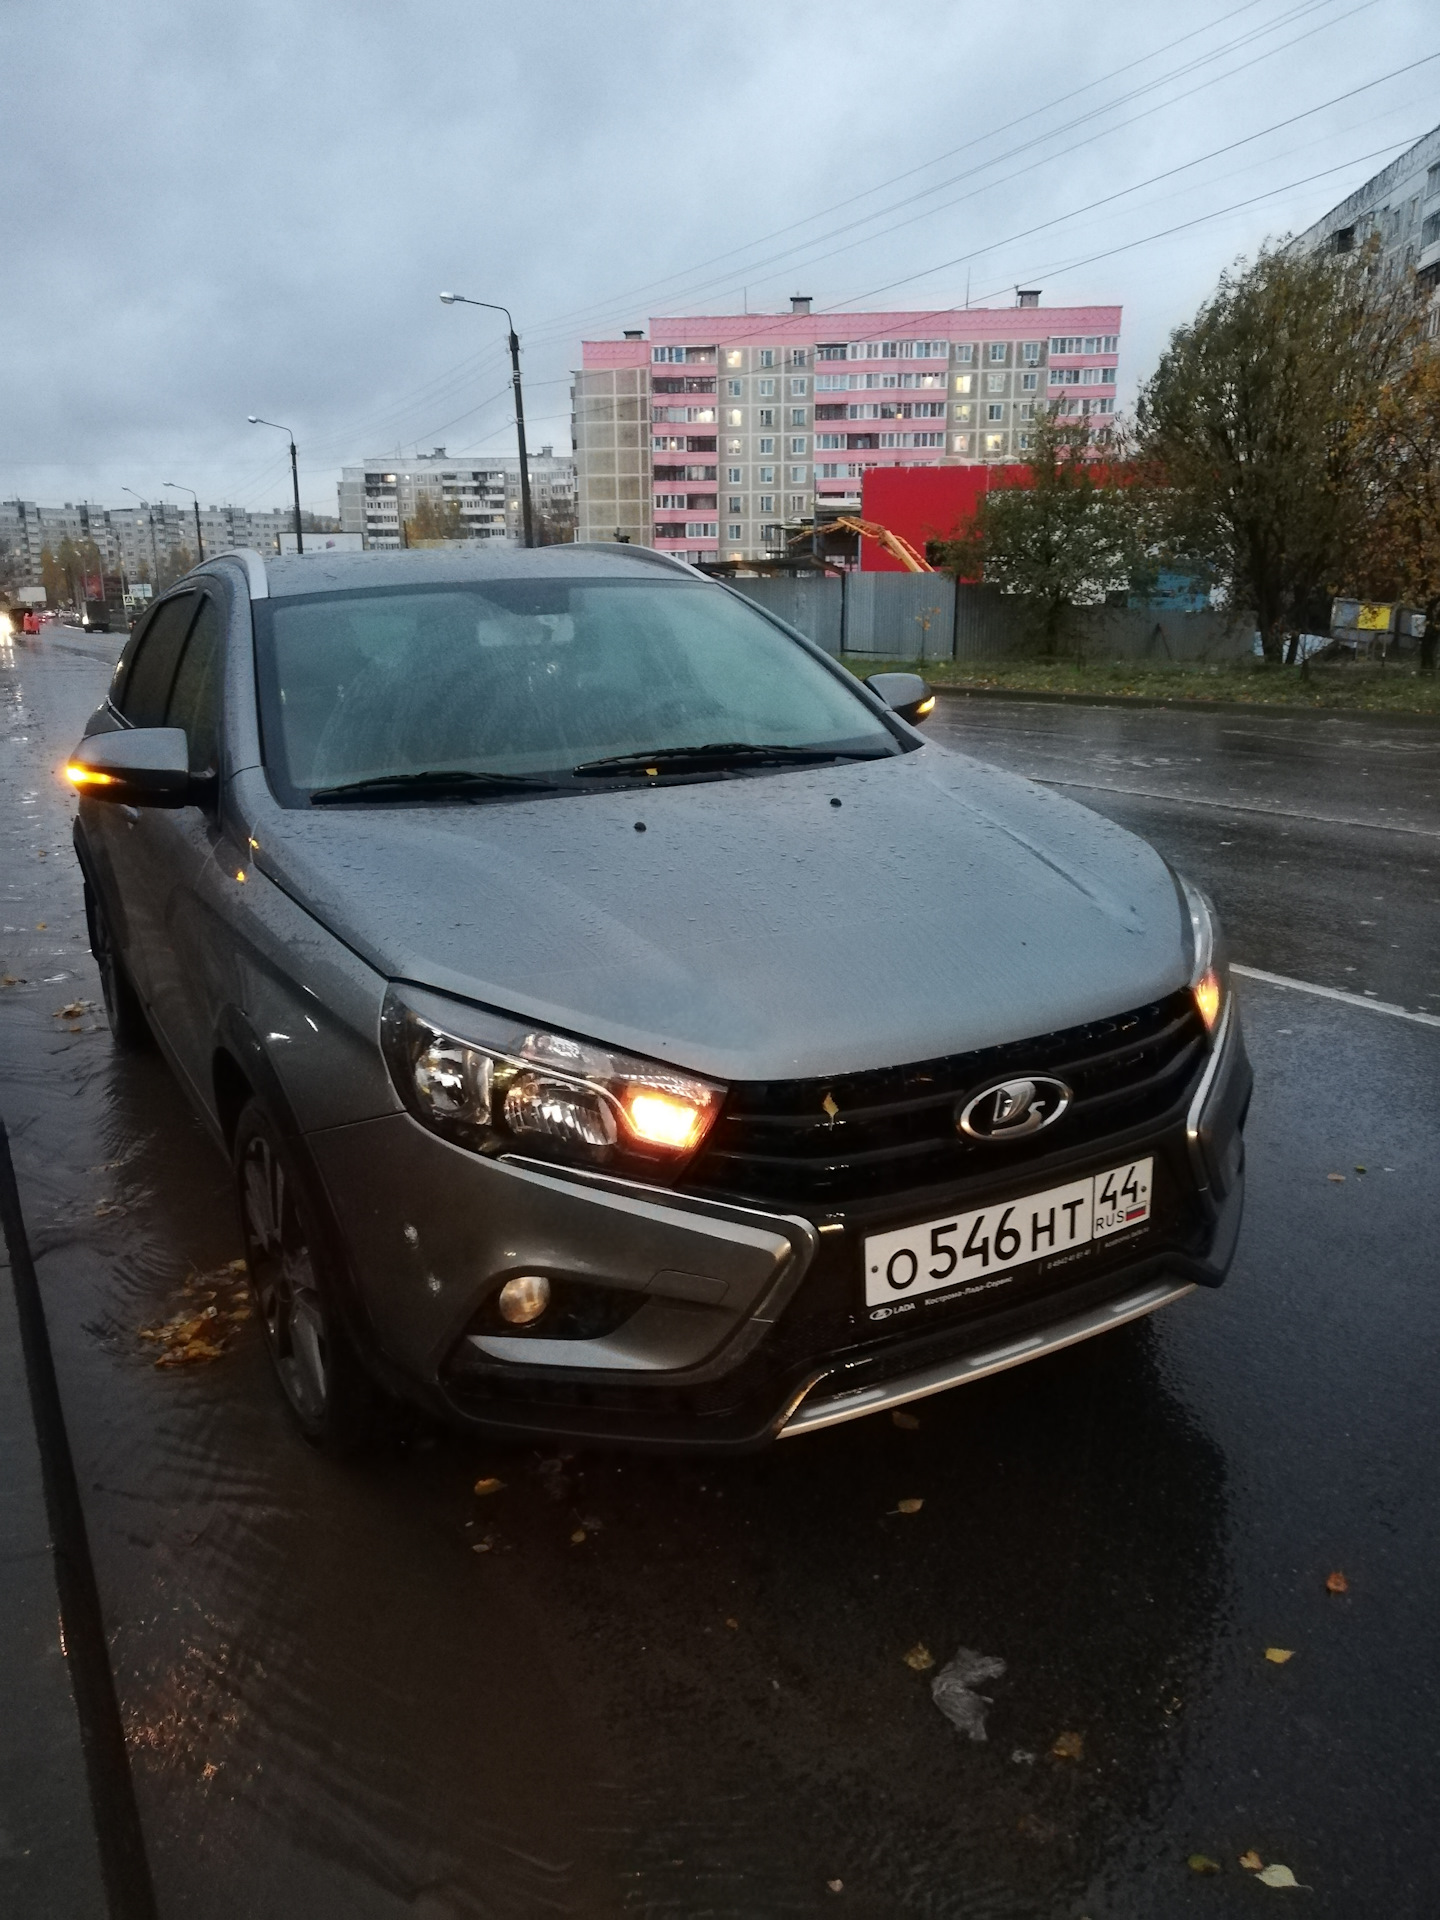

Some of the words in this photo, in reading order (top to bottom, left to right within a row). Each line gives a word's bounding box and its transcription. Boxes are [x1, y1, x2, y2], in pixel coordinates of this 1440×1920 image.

[1100, 1166, 1139, 1210] 44
[1096, 1210, 1125, 1230] RUS
[893, 1303, 916, 1314] LADA
